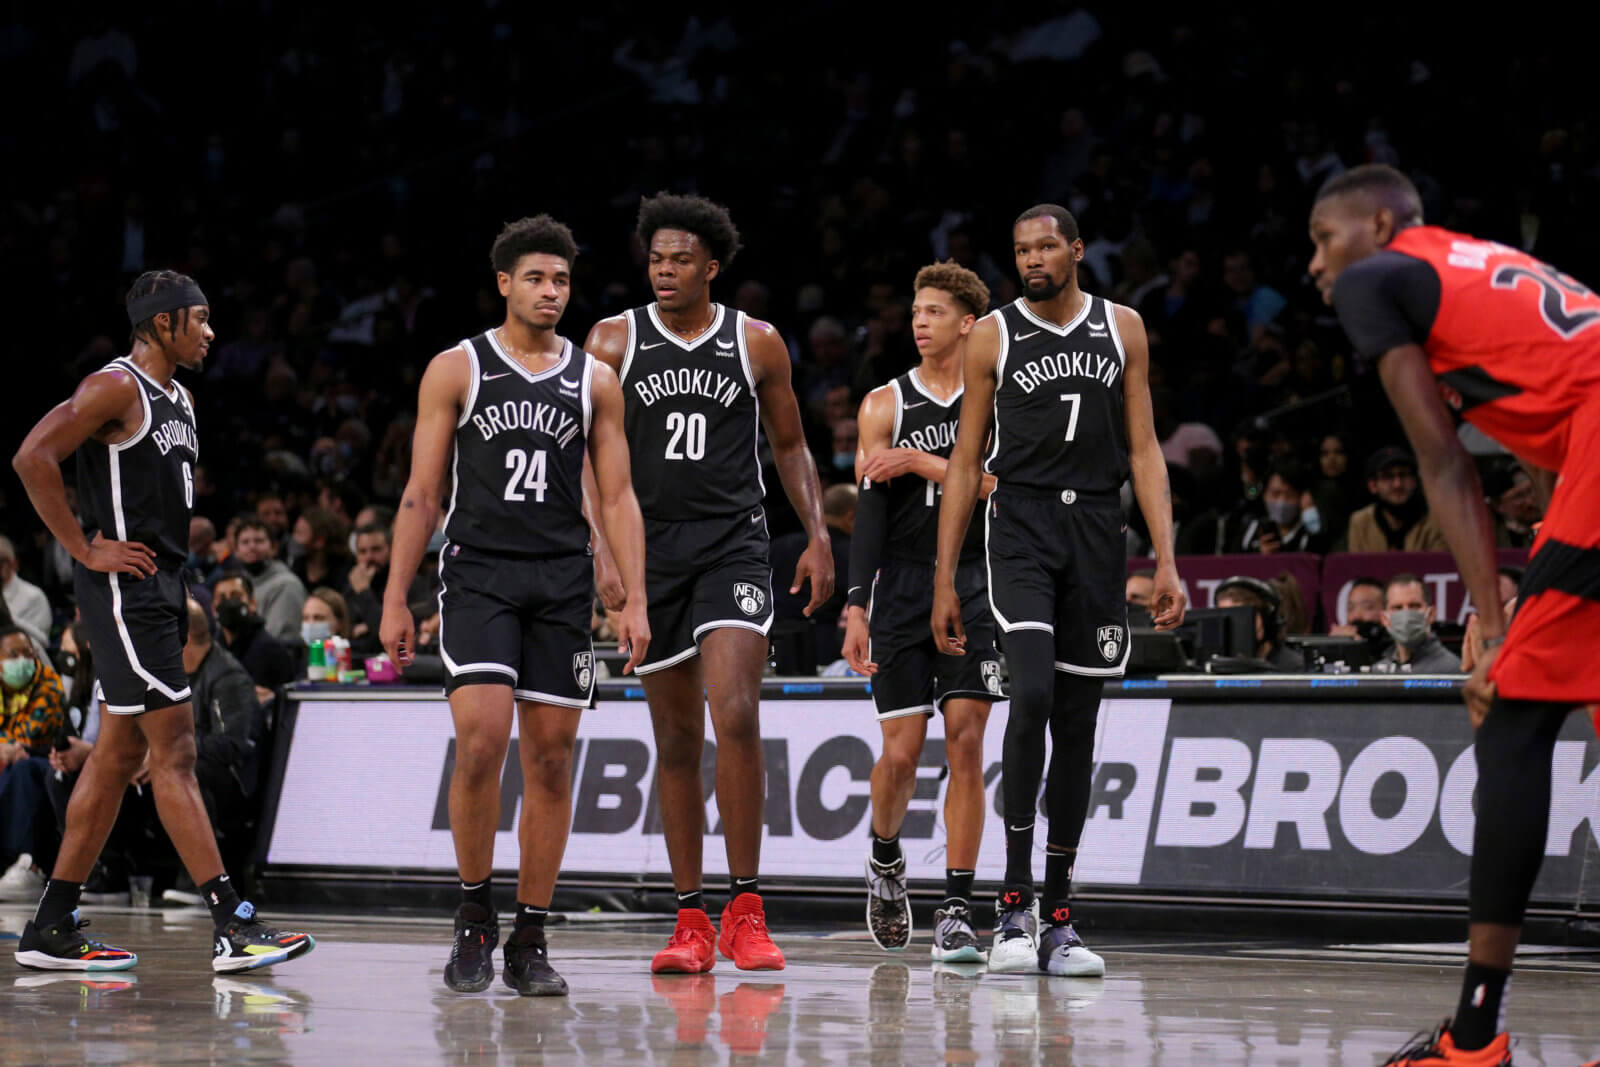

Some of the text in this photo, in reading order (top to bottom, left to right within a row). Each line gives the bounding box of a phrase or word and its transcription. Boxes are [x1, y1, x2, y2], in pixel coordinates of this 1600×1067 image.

[634, 368, 742, 408] BROOKLYN
[1012, 351, 1120, 394] BROOKLYN
[472, 400, 580, 450] BROOKLYN
[665, 412, 707, 461] 20
[1060, 393, 1081, 441] 7
[182, 461, 193, 509] 6
[503, 449, 548, 503] 24
[736, 584, 764, 604] NETS
[1099, 628, 1121, 642] NETS
